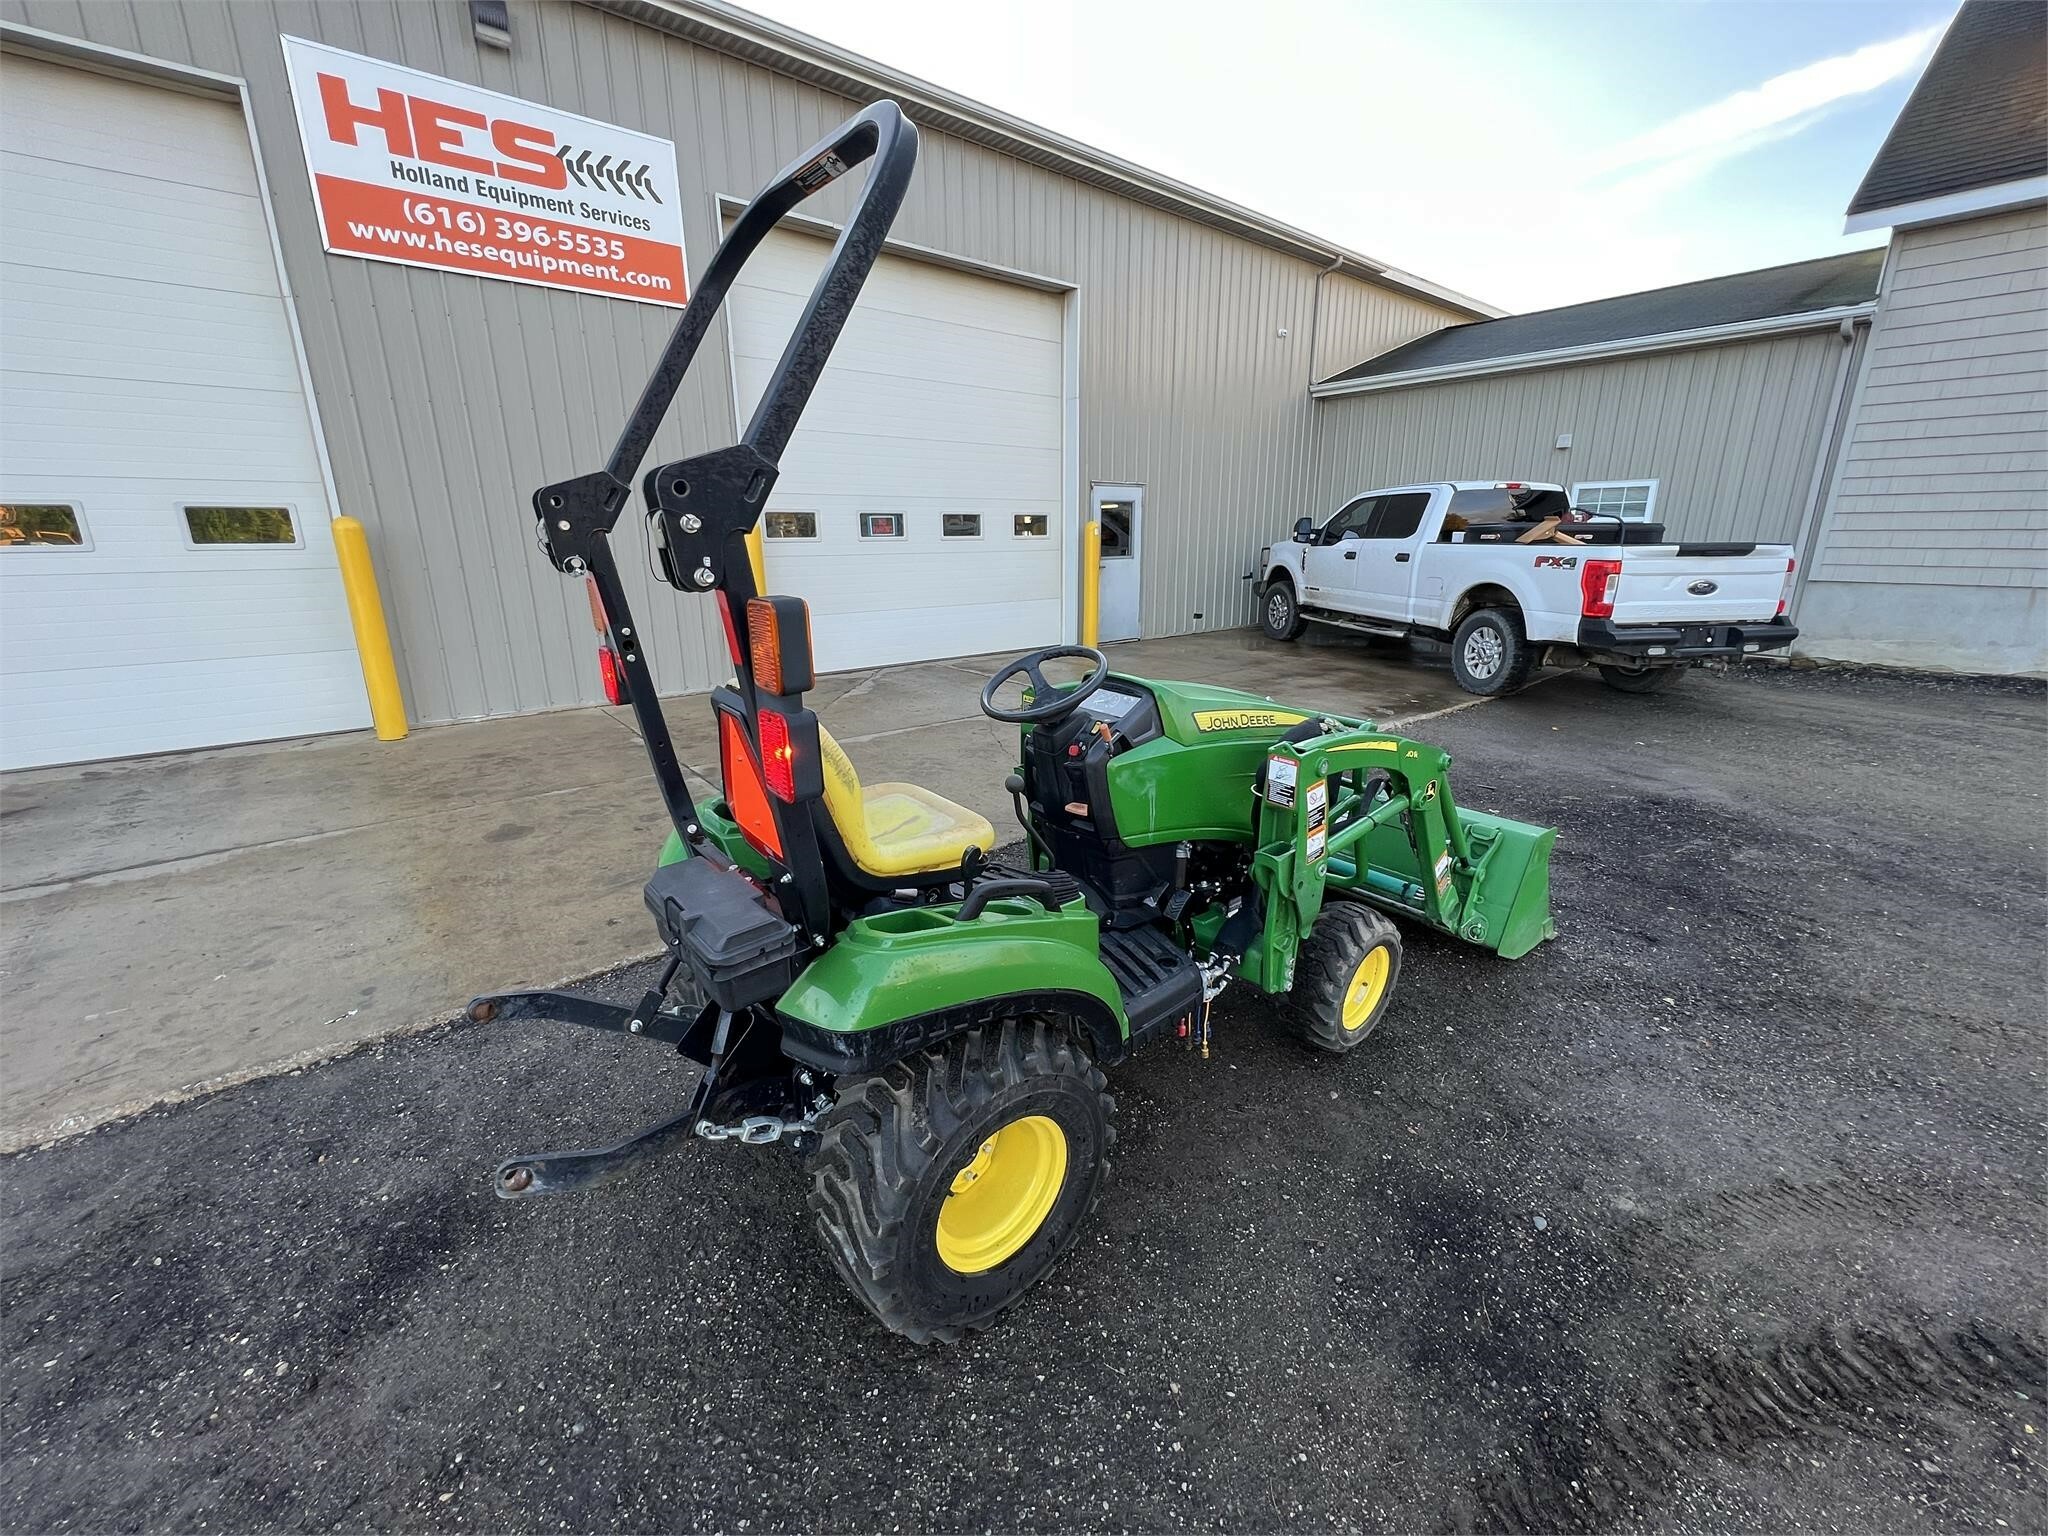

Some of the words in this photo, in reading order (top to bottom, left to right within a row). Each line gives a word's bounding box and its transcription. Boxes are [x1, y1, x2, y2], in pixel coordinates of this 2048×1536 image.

[316, 72, 567, 190] HES
[390, 160, 470, 194] Holland
[475, 179, 576, 216] Equipment
[580, 202, 652, 233] Services
[403, 198, 486, 236] (616)
[495, 216, 625, 261] 396-5535
[347, 217, 673, 291] www.hesequipment.com
[1534, 556, 1577, 567] FX4
[1206, 716, 1238, 729] JOHN
[1240, 714, 1276, 726] DEERE
